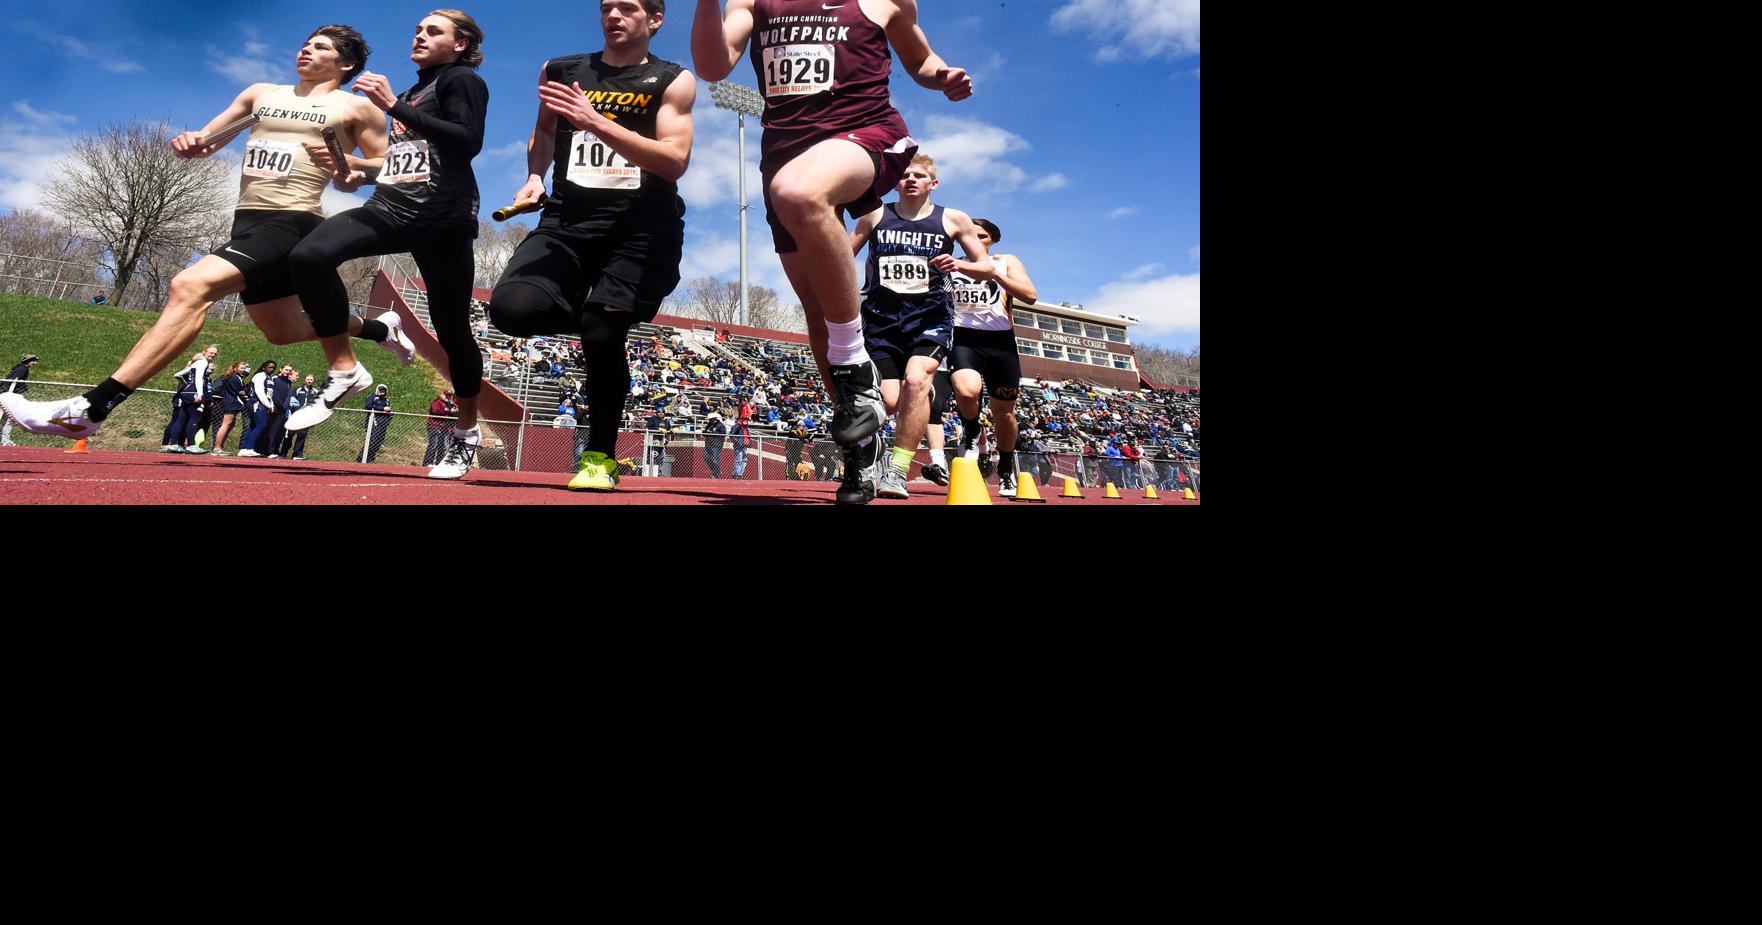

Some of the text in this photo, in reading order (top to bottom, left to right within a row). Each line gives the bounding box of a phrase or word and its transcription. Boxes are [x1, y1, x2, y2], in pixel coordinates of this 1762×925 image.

[769, 15, 838, 24] WESTERN CHRISTIAN
[760, 26, 850, 46] WOLFPACK
[768, 58, 830, 86] 1929
[584, 90, 653, 106] INTON
[257, 106, 327, 124] GLENWOOD
[247, 149, 292, 172] 1040
[384, 152, 427, 176] 1522
[877, 229, 944, 249] KNIGHTS
[883, 264, 926, 280] 1889
[956, 290, 988, 304] 1354
[1042, 332, 1107, 350] MORNINGSIDE COLLEGE
